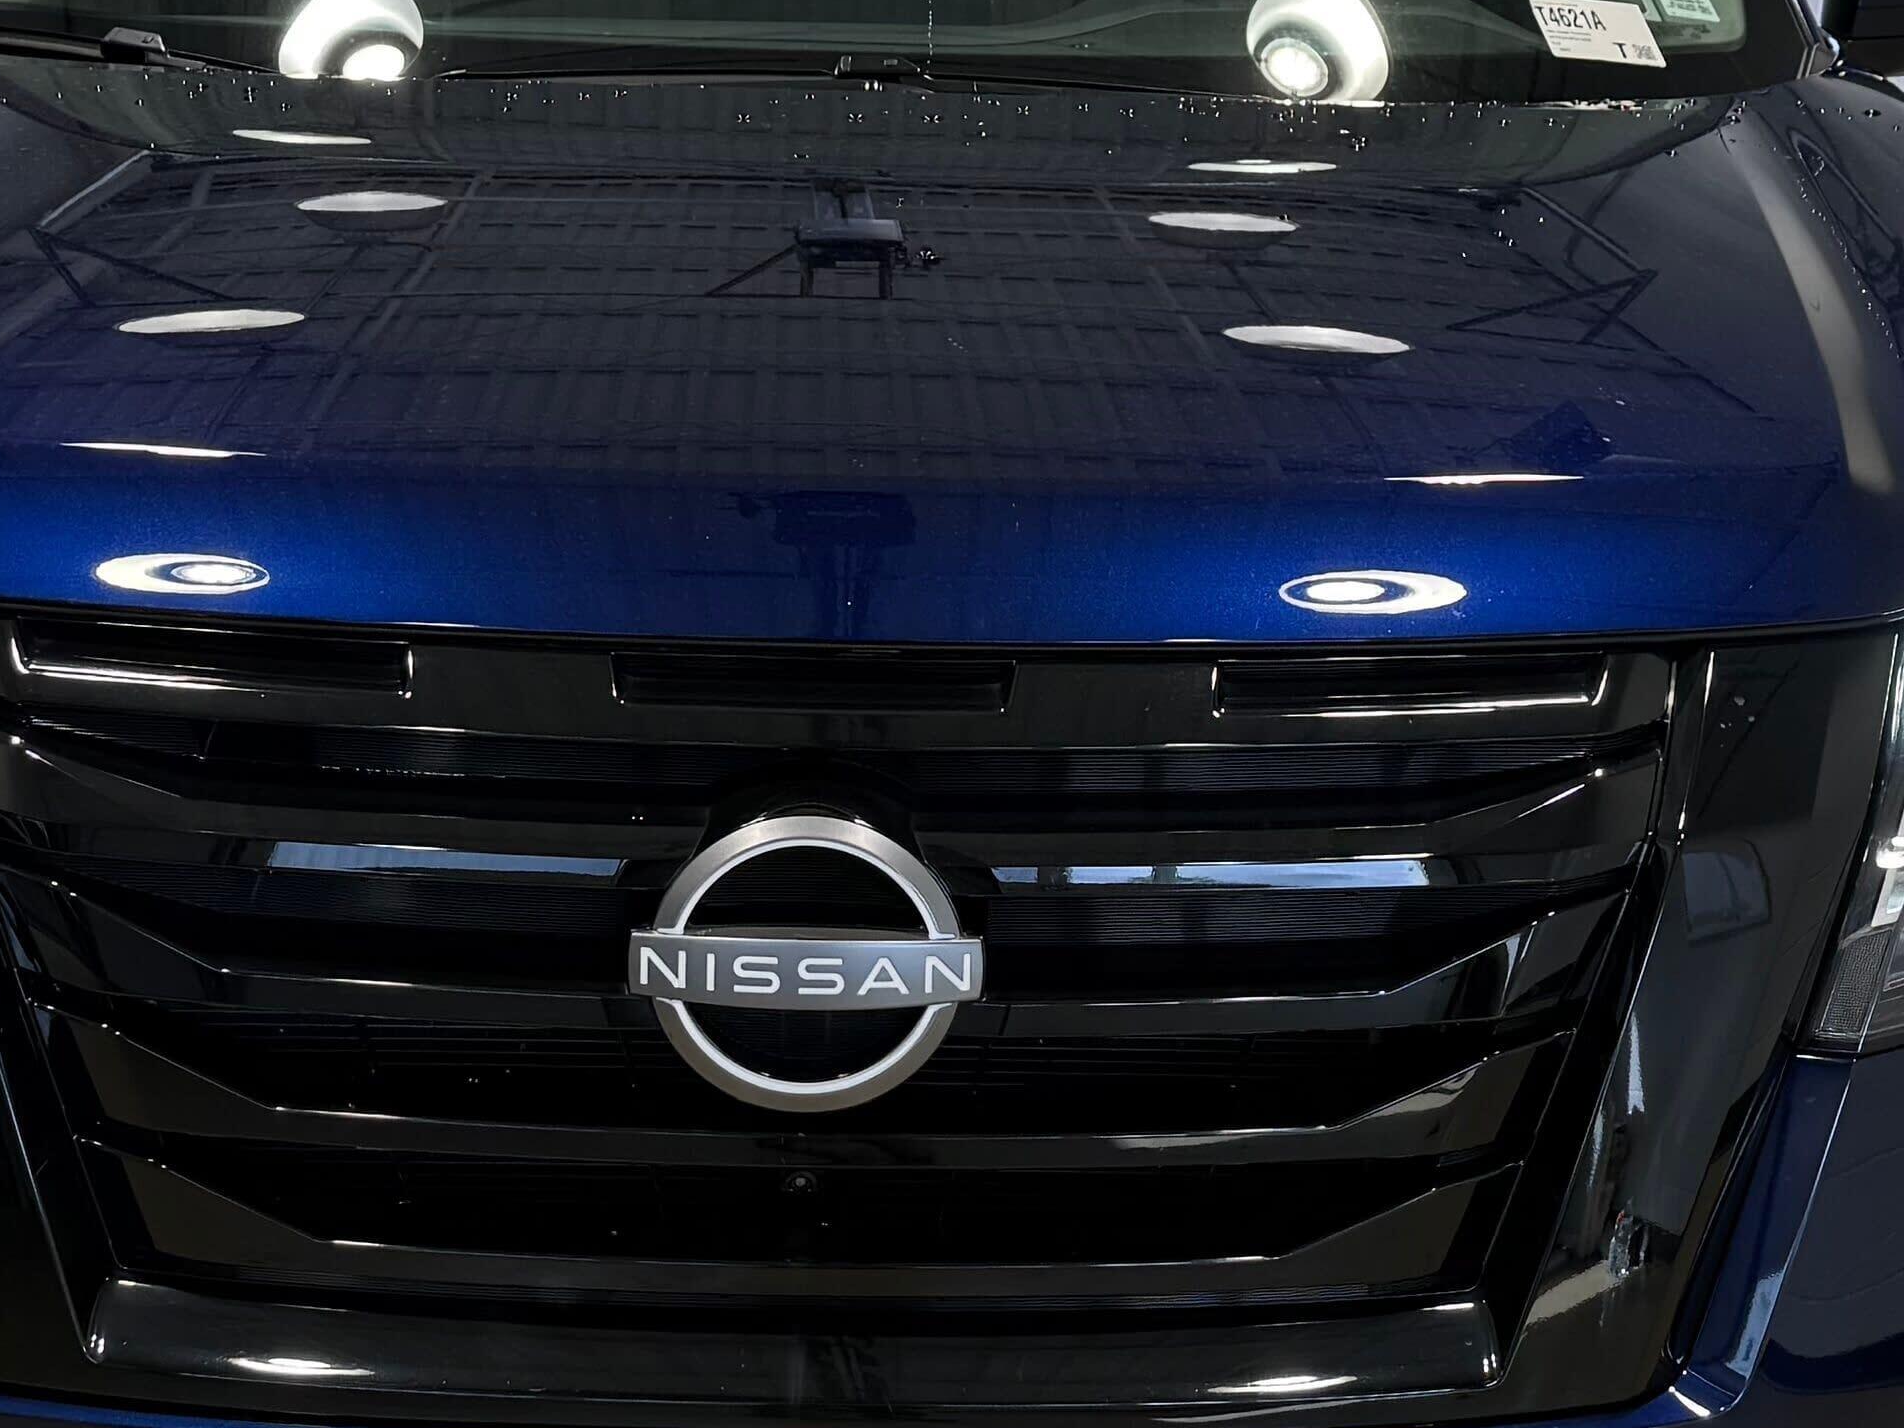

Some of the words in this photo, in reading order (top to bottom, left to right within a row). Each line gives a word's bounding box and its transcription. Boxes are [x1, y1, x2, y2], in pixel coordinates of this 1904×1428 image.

[1534, 6, 1607, 31] T4621A
[1613, 42, 1627, 59] T
[639, 946, 971, 996] NISSAN
